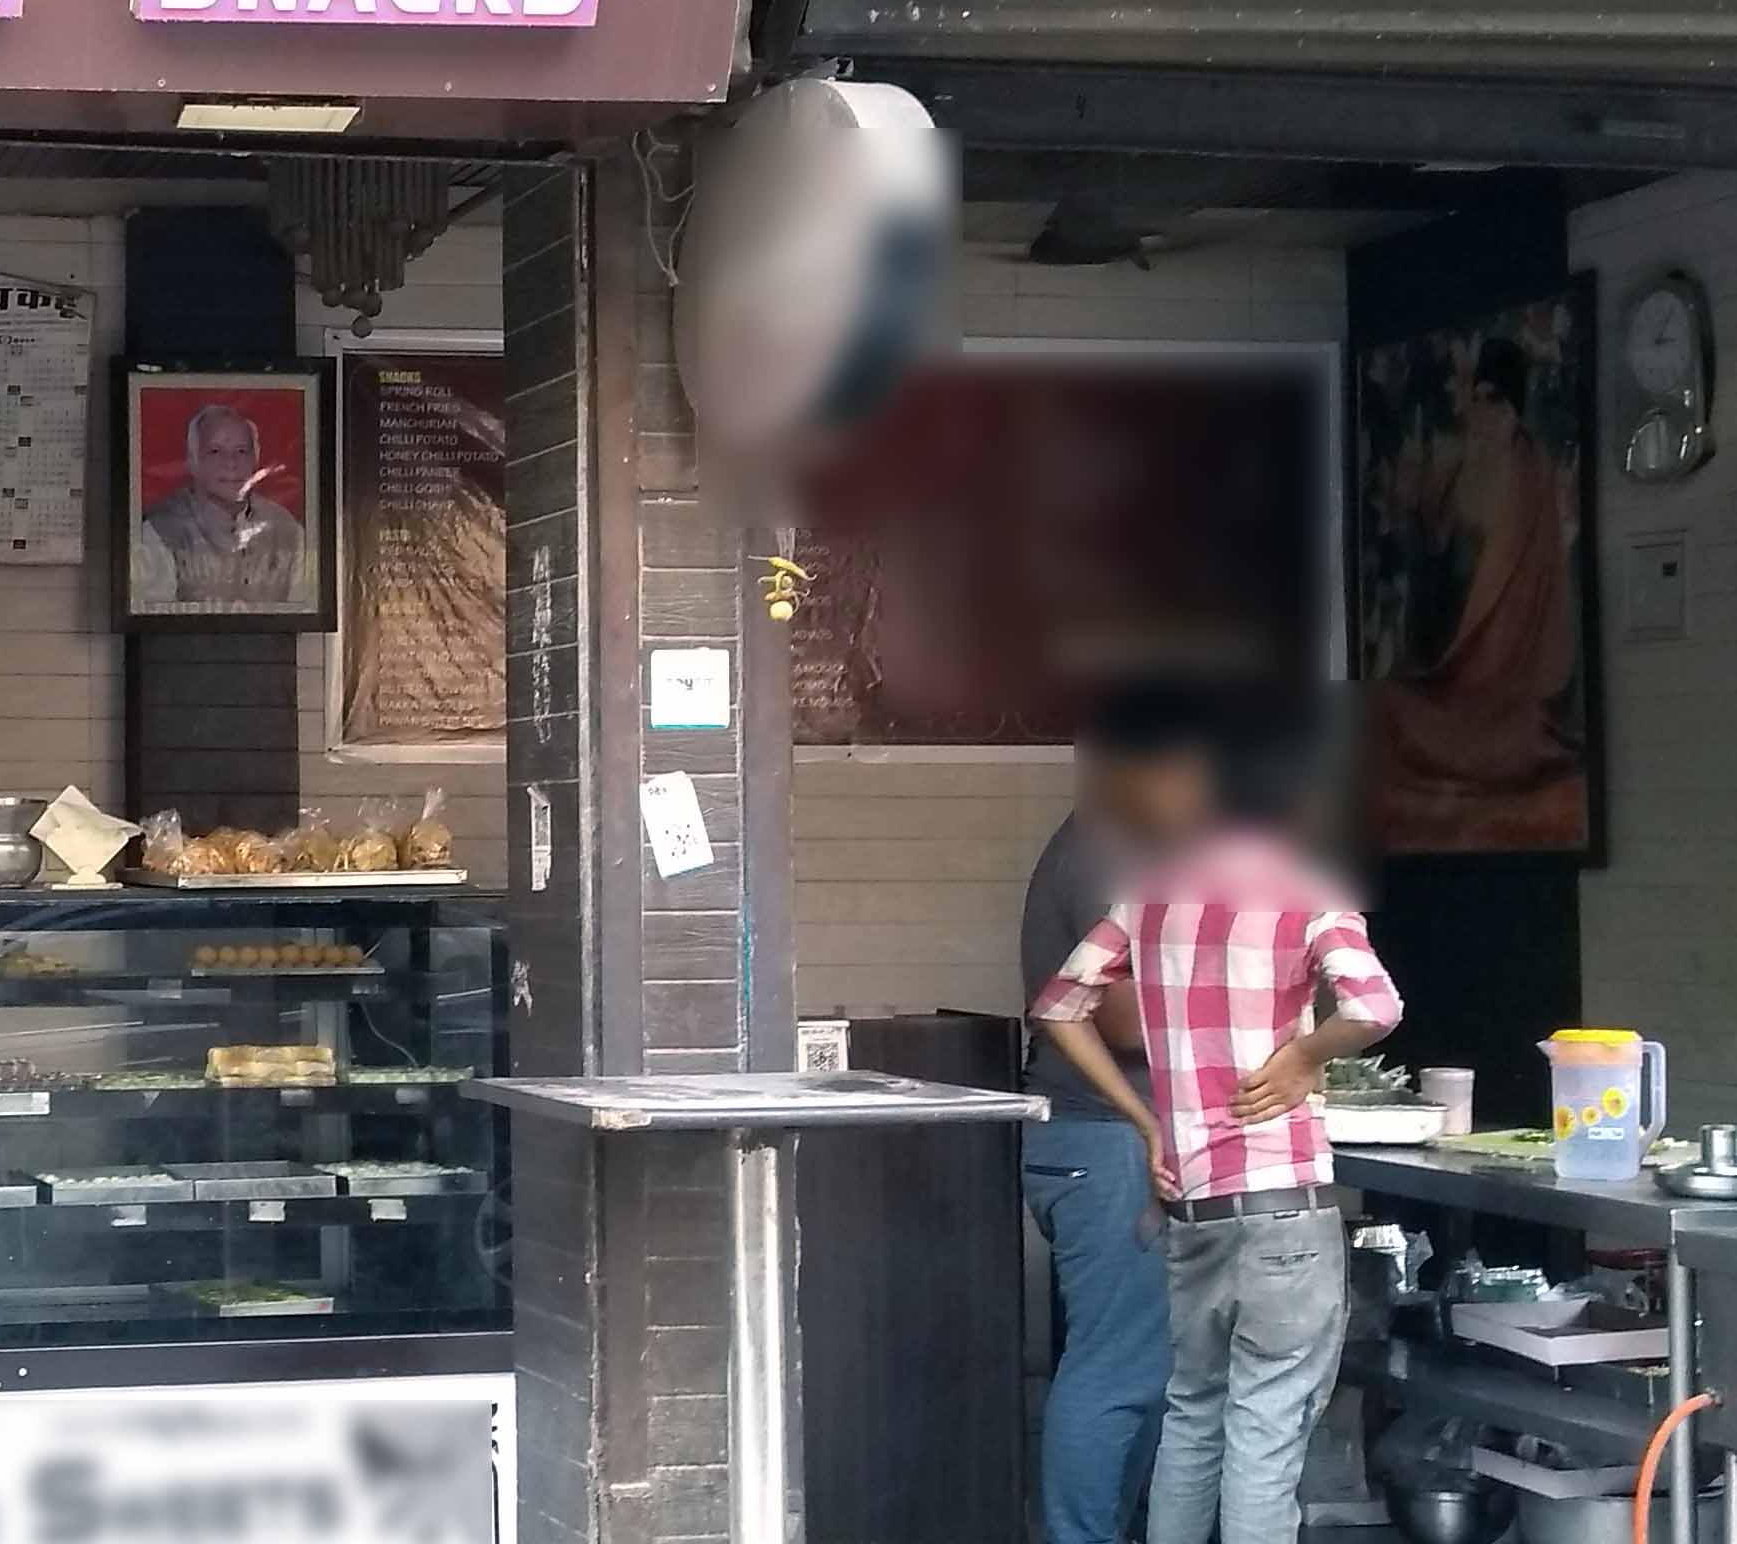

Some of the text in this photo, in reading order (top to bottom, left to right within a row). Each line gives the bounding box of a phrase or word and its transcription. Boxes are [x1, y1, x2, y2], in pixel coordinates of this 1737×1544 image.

[425, 386, 452, 397] ROLL
[379, 434, 459, 446] CHILLI POTATO
[379, 450, 419, 462] HONEY
[457, 451, 500, 463] POTATO
